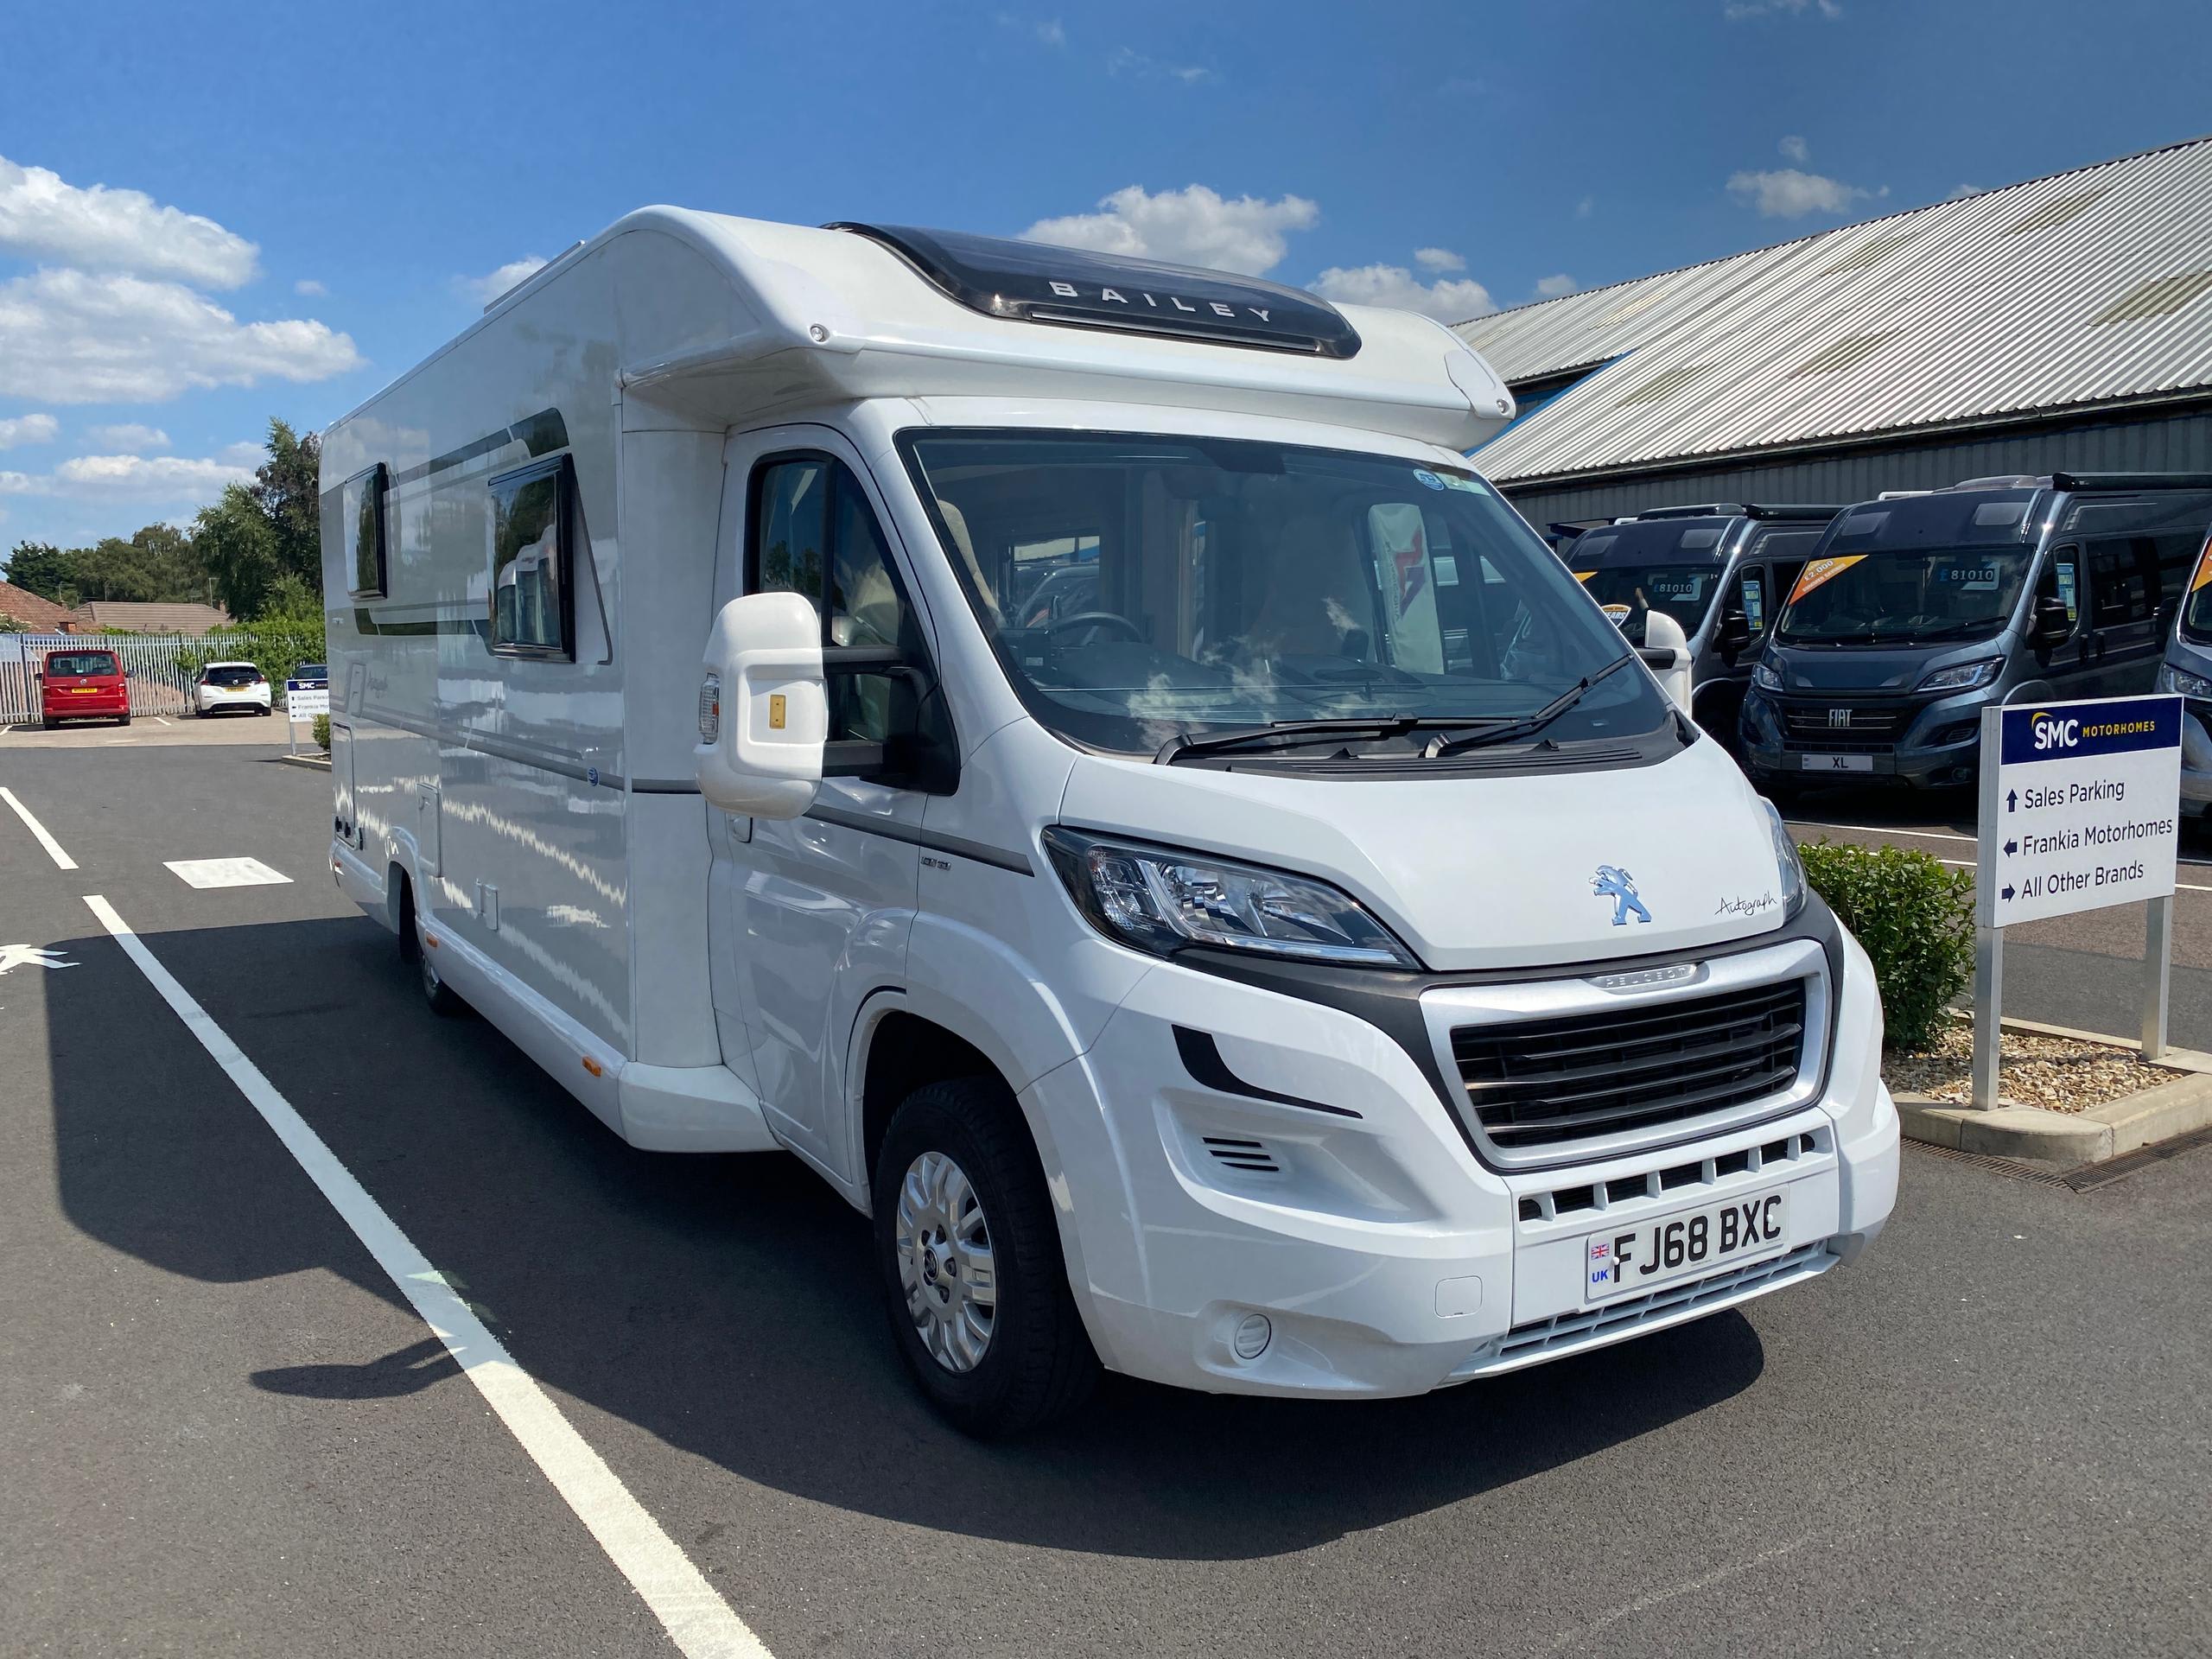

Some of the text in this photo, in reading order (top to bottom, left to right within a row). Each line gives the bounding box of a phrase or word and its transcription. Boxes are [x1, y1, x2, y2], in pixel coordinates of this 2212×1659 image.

[1049, 281, 1269, 322] BAILEY
[1605, 611, 1626, 620] EARS
[1828, 709, 1853, 727] FIAT
[2034, 719, 2156, 750] SMC MOTORHOMES
[1833, 757, 1849, 769] XL
[2024, 779, 2125, 809] Sales Parking
[2024, 819, 2172, 856] Frankia Motorhomes
[2021, 860, 2144, 899] All Other Brands
[1714, 889, 1777, 916] Autograph
[1613, 1195, 1782, 1283] FJ68 BXC
[1592, 1268, 1608, 1283] UK
